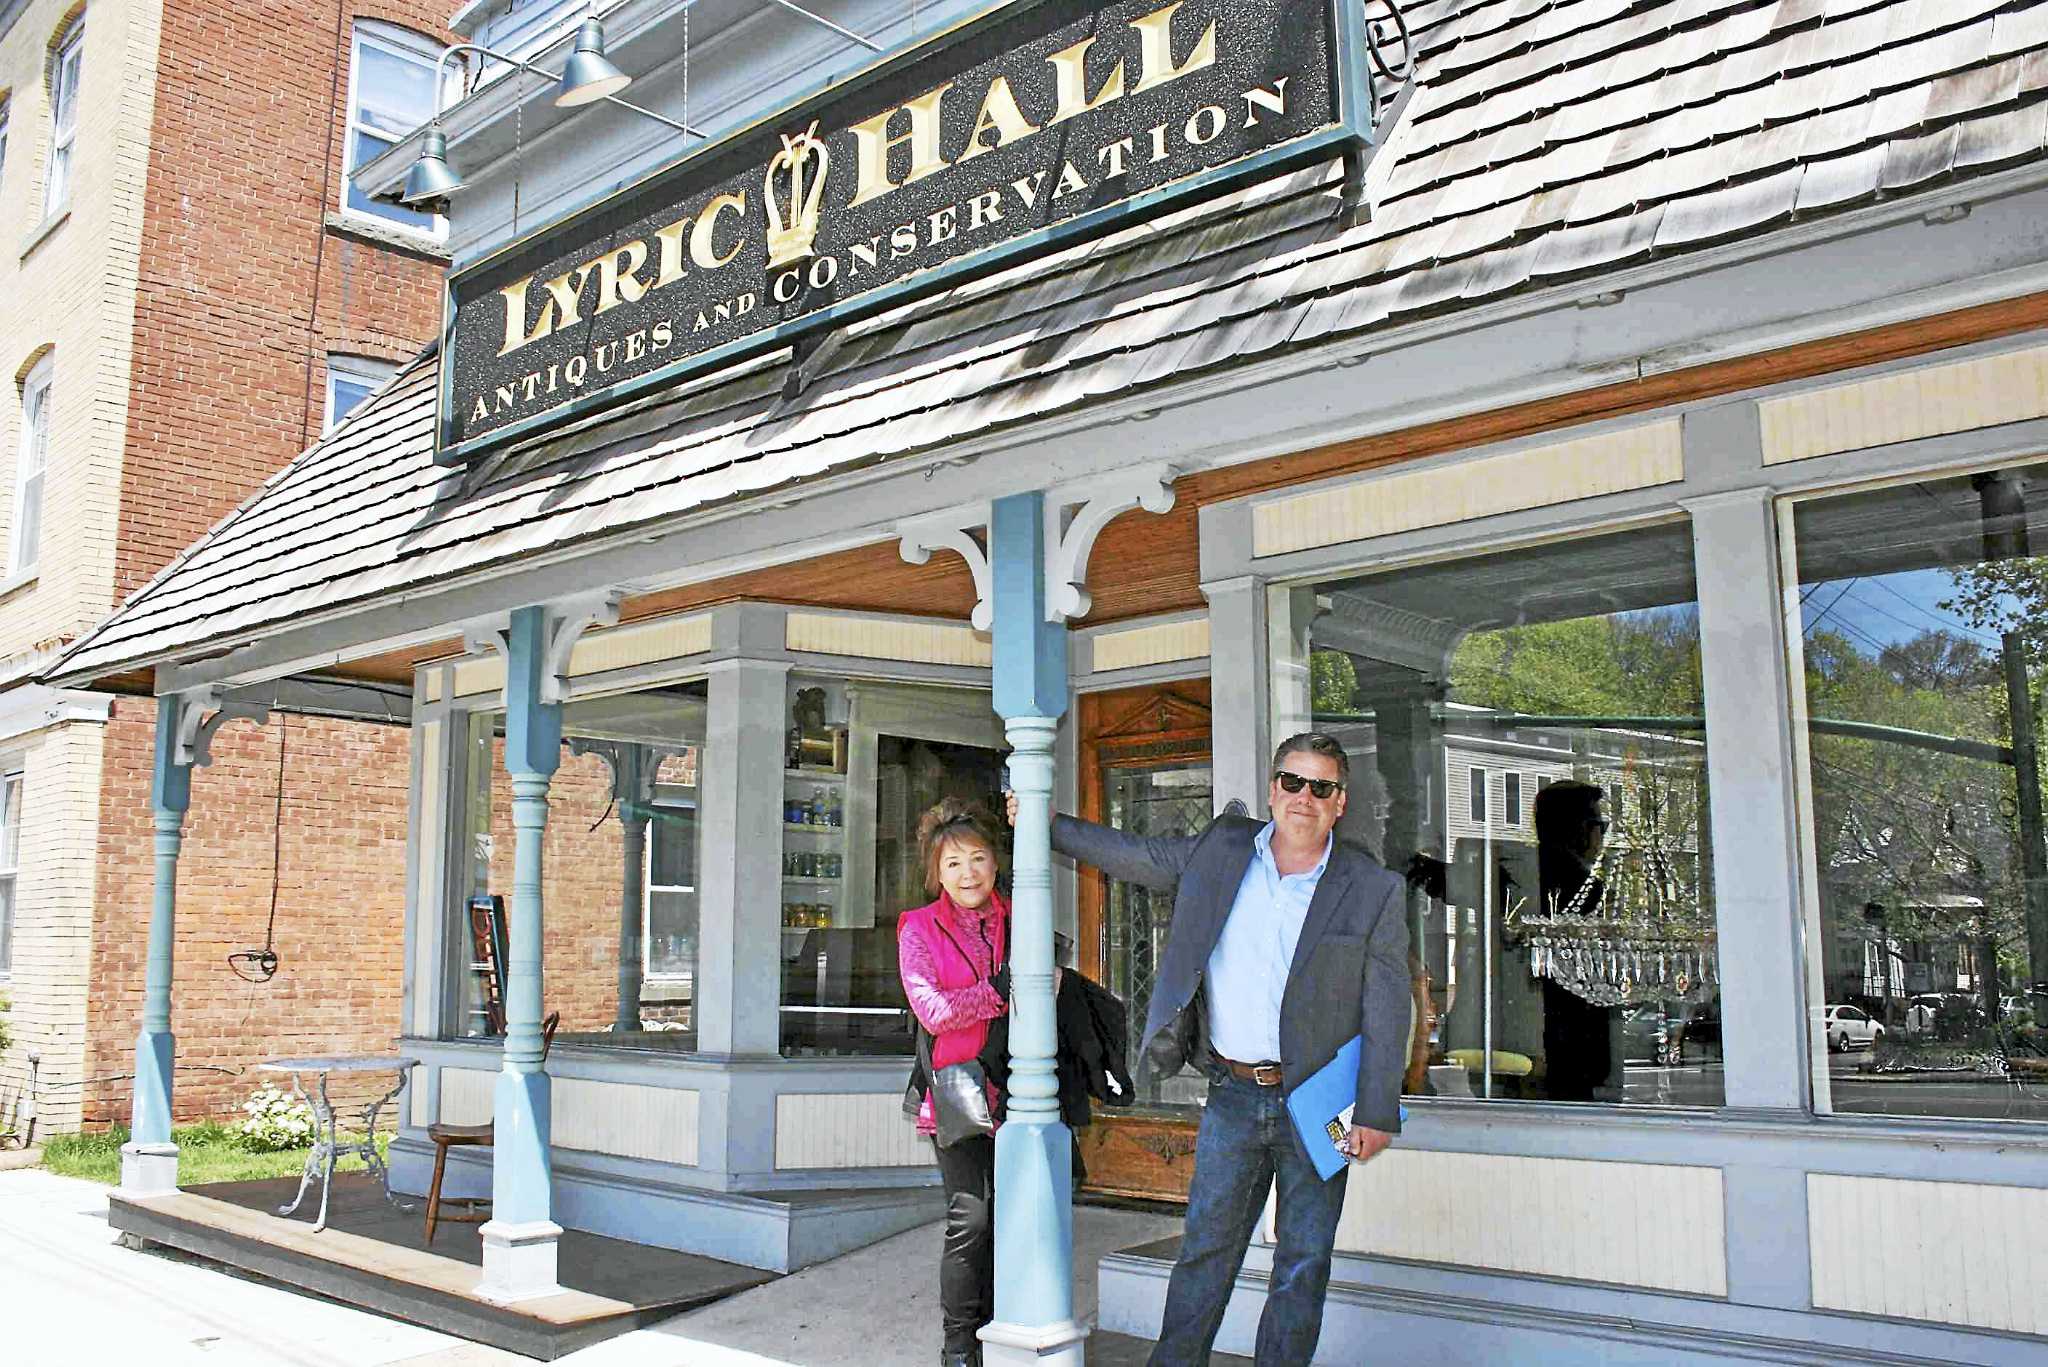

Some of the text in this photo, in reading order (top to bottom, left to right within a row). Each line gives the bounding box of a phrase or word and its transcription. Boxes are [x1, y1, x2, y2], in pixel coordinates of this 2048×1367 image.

[471, 76, 1290, 423] ANTIQUES AND CONSERVATION
[496, 1, 1217, 358] LYRIC HALL
